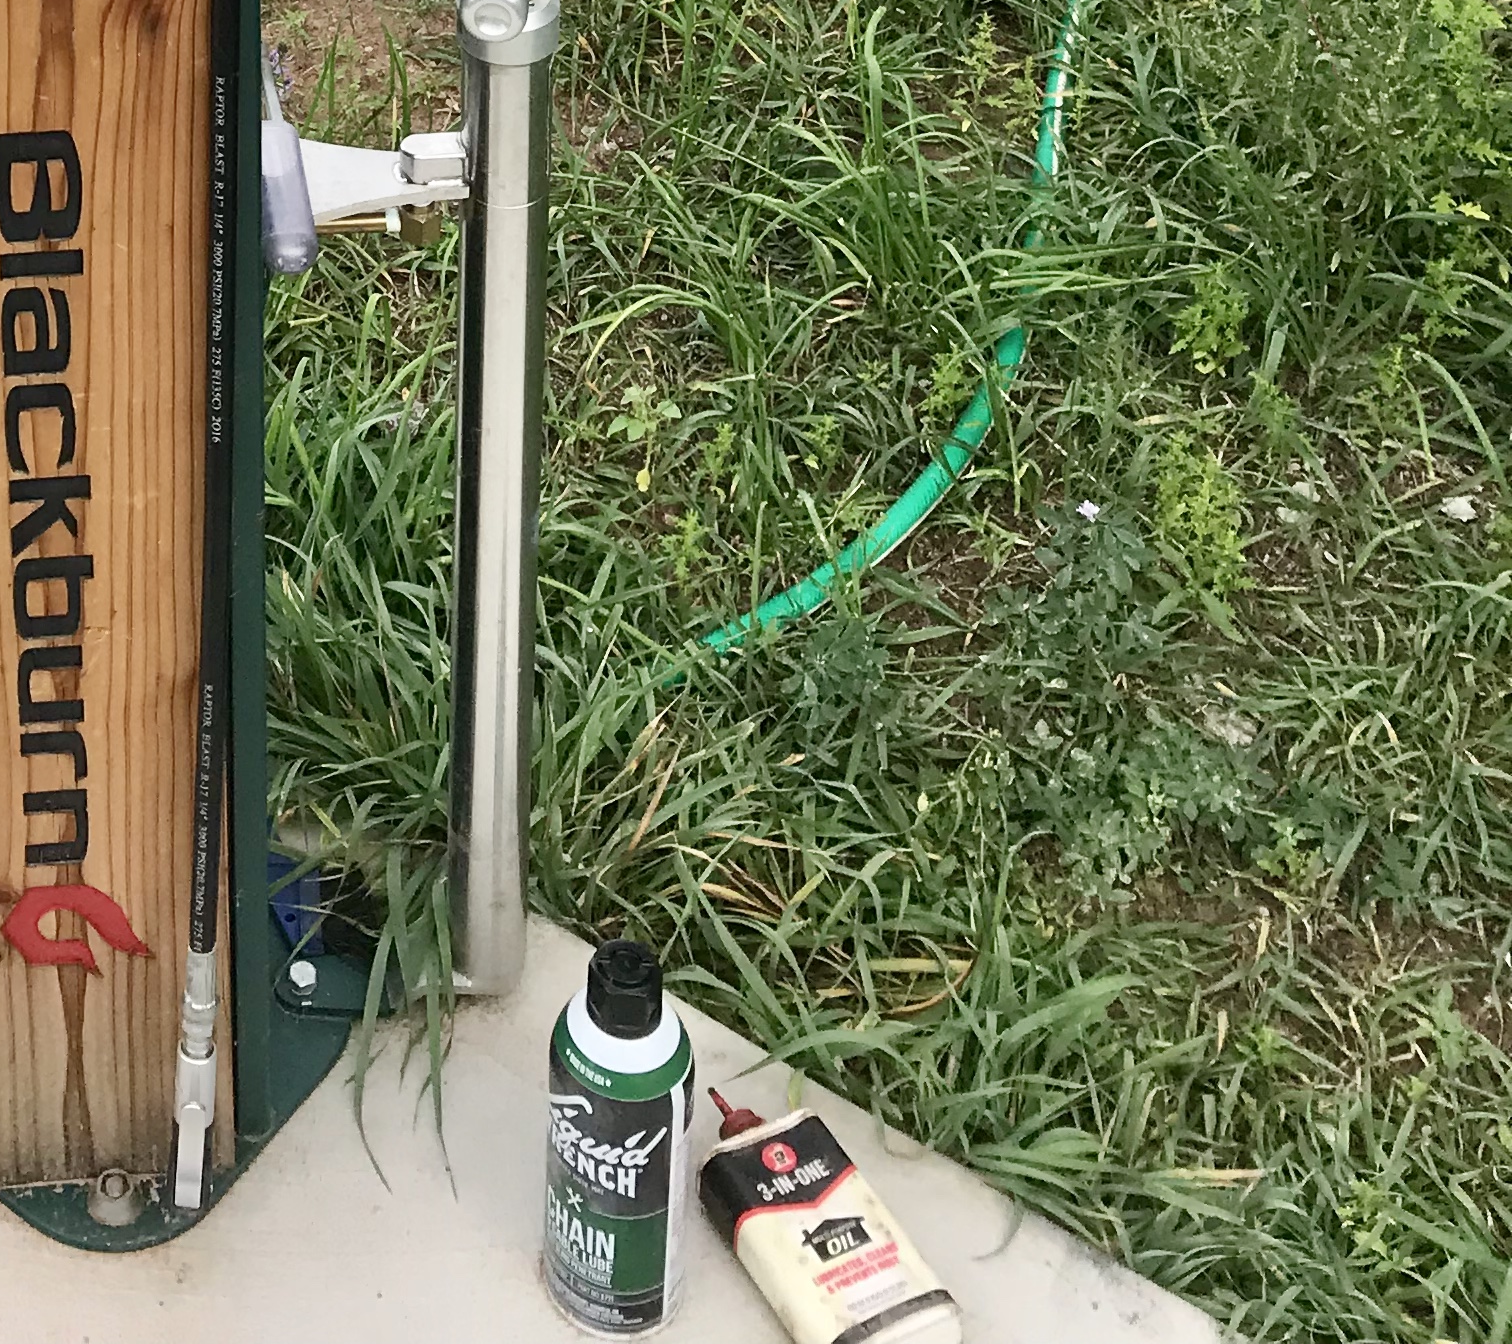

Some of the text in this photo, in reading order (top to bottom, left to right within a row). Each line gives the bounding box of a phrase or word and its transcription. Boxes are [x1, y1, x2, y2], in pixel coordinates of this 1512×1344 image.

[216, 76, 224, 126] RAPTOR
[215, 135, 224, 174] BLAST
[215, 180, 223, 207] R-17
[214, 240, 223, 266] 3000
[212, 347, 221, 366] 275
[212, 369, 221, 410] F(135C)
[203, 684, 212, 728] RAPTOR
[201, 733, 210, 769] BLAST
[194, 920, 203, 939] 275
[757, 1159, 830, 1202] 3-IN-ONE
[548, 1184, 614, 1260] CHAIN
[826, 1231, 860, 1256] OIL
[583, 1252, 613, 1273] LUBE
